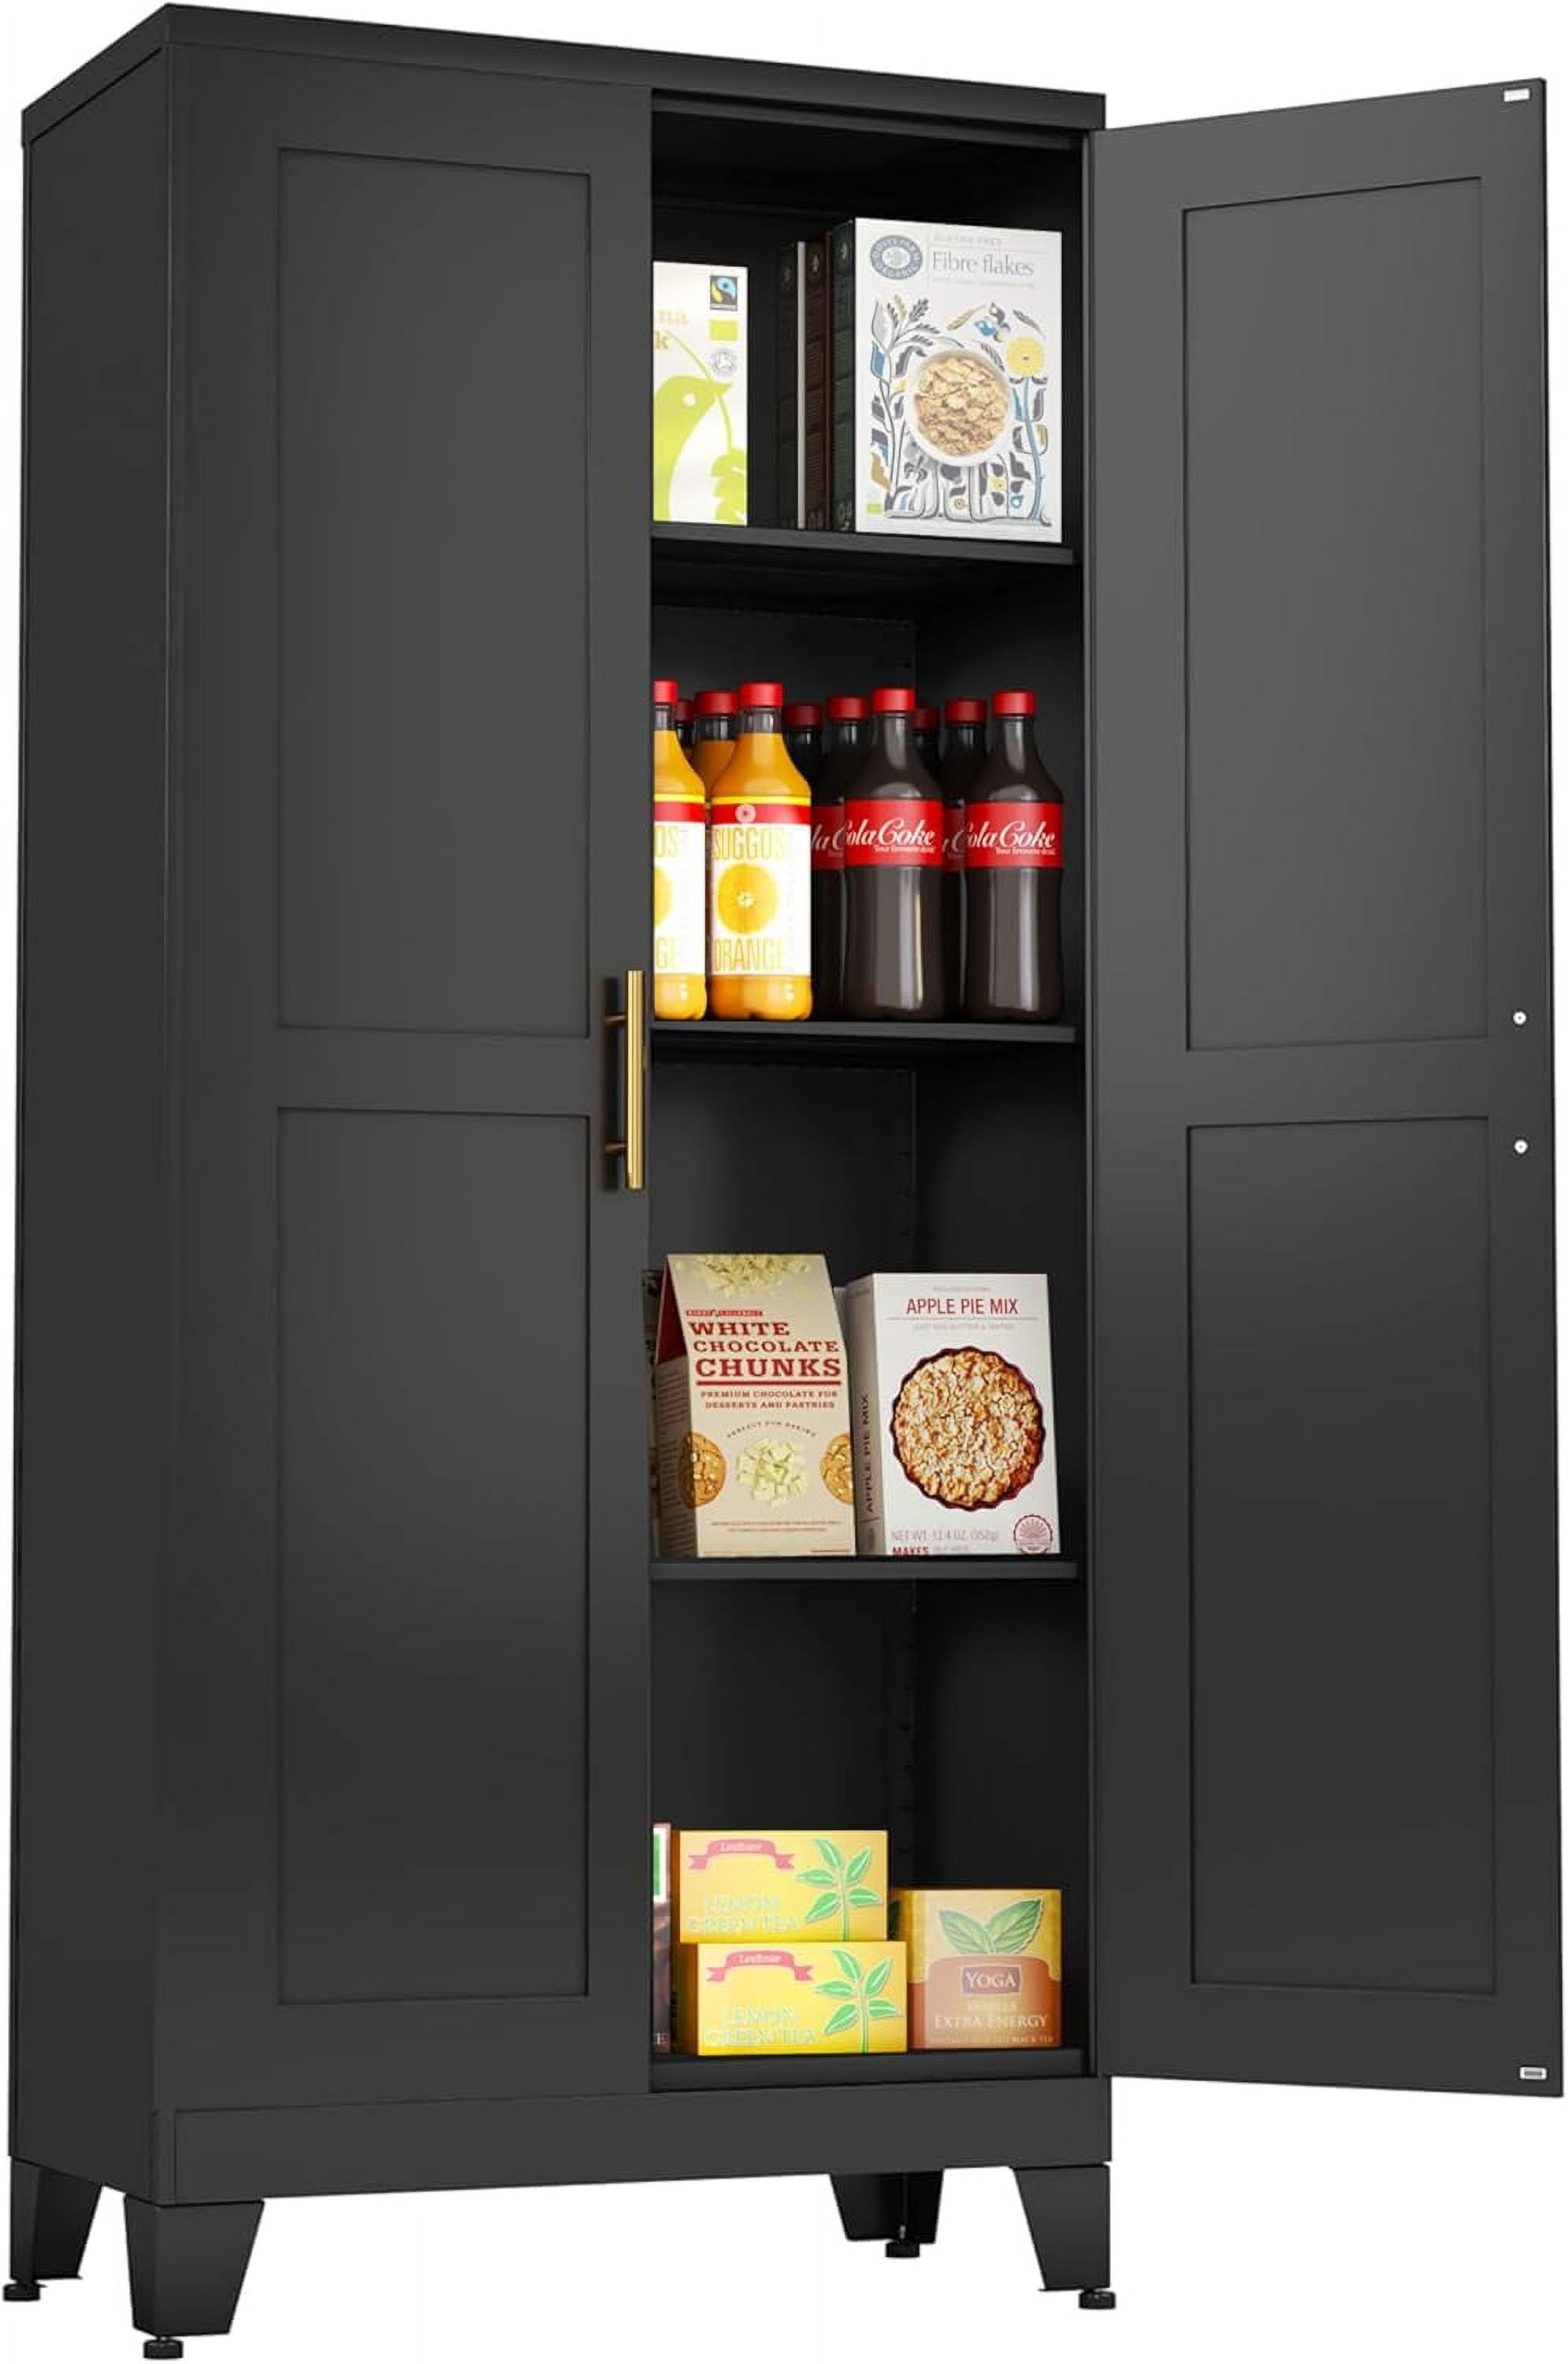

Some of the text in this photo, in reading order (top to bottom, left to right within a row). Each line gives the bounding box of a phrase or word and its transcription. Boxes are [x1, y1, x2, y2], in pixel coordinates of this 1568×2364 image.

[932, 251, 1035, 277] Fibre flakes
[877, 816, 936, 846] Coke
[998, 819, 1057, 849] Coke
[906, 1298, 1020, 1315] APPLE PIE MIX
[688, 1321, 790, 1336] WHITE
[693, 1340, 840, 1353] CHOCOLATE
[695, 1358, 842, 1377] CHUNKS
[700, 1390, 751, 1399] PREMIUM
[753, 1390, 815, 1399] CHOCOLATE
[860, 1393, 871, 1426] MIX
[863, 1435, 871, 1457] PIE
[865, 1461, 875, 1514] APPLE
[964, 1970, 1017, 1990] YOGA
[933, 2013, 1049, 2030] EXTRA ENERGY
